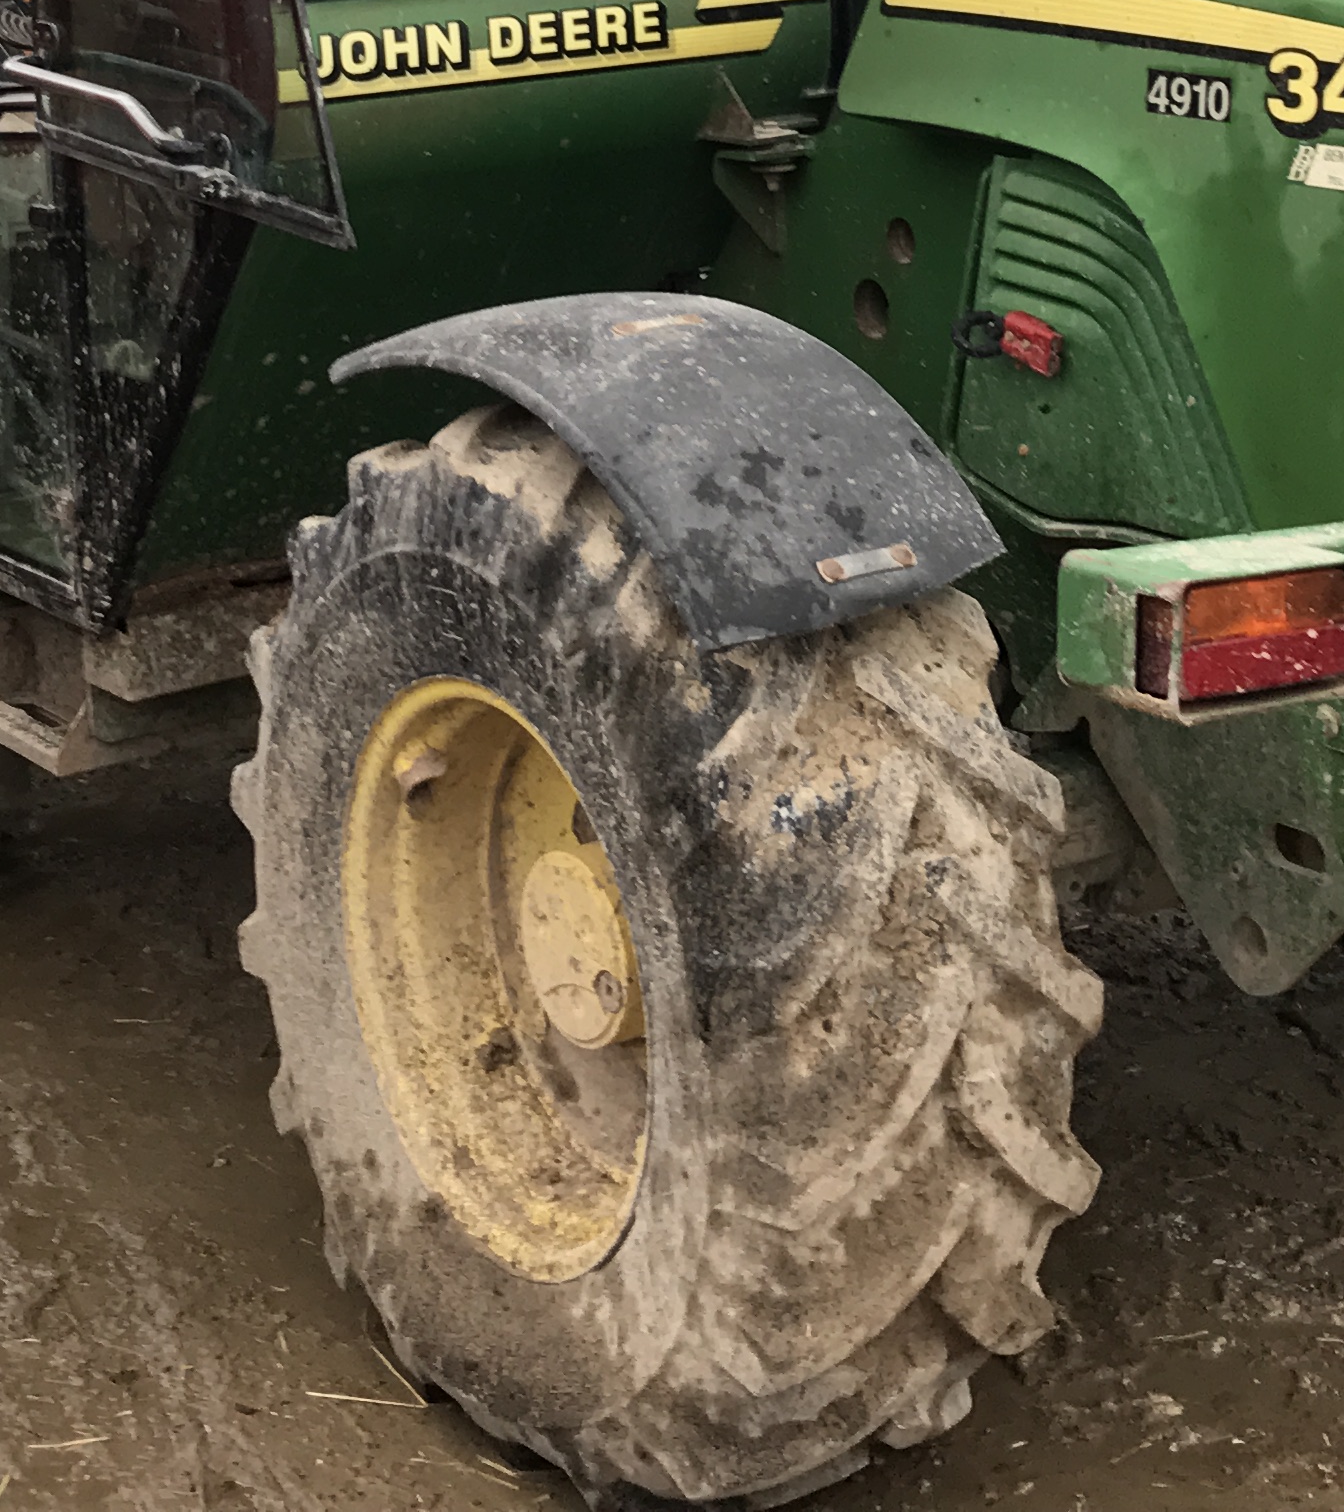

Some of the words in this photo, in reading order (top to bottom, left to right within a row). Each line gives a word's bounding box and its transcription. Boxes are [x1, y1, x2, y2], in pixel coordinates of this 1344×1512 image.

[317, 21, 466, 81] JOHN
[488, 1, 665, 63] DEERE
[1147, 75, 1230, 122] 4910
